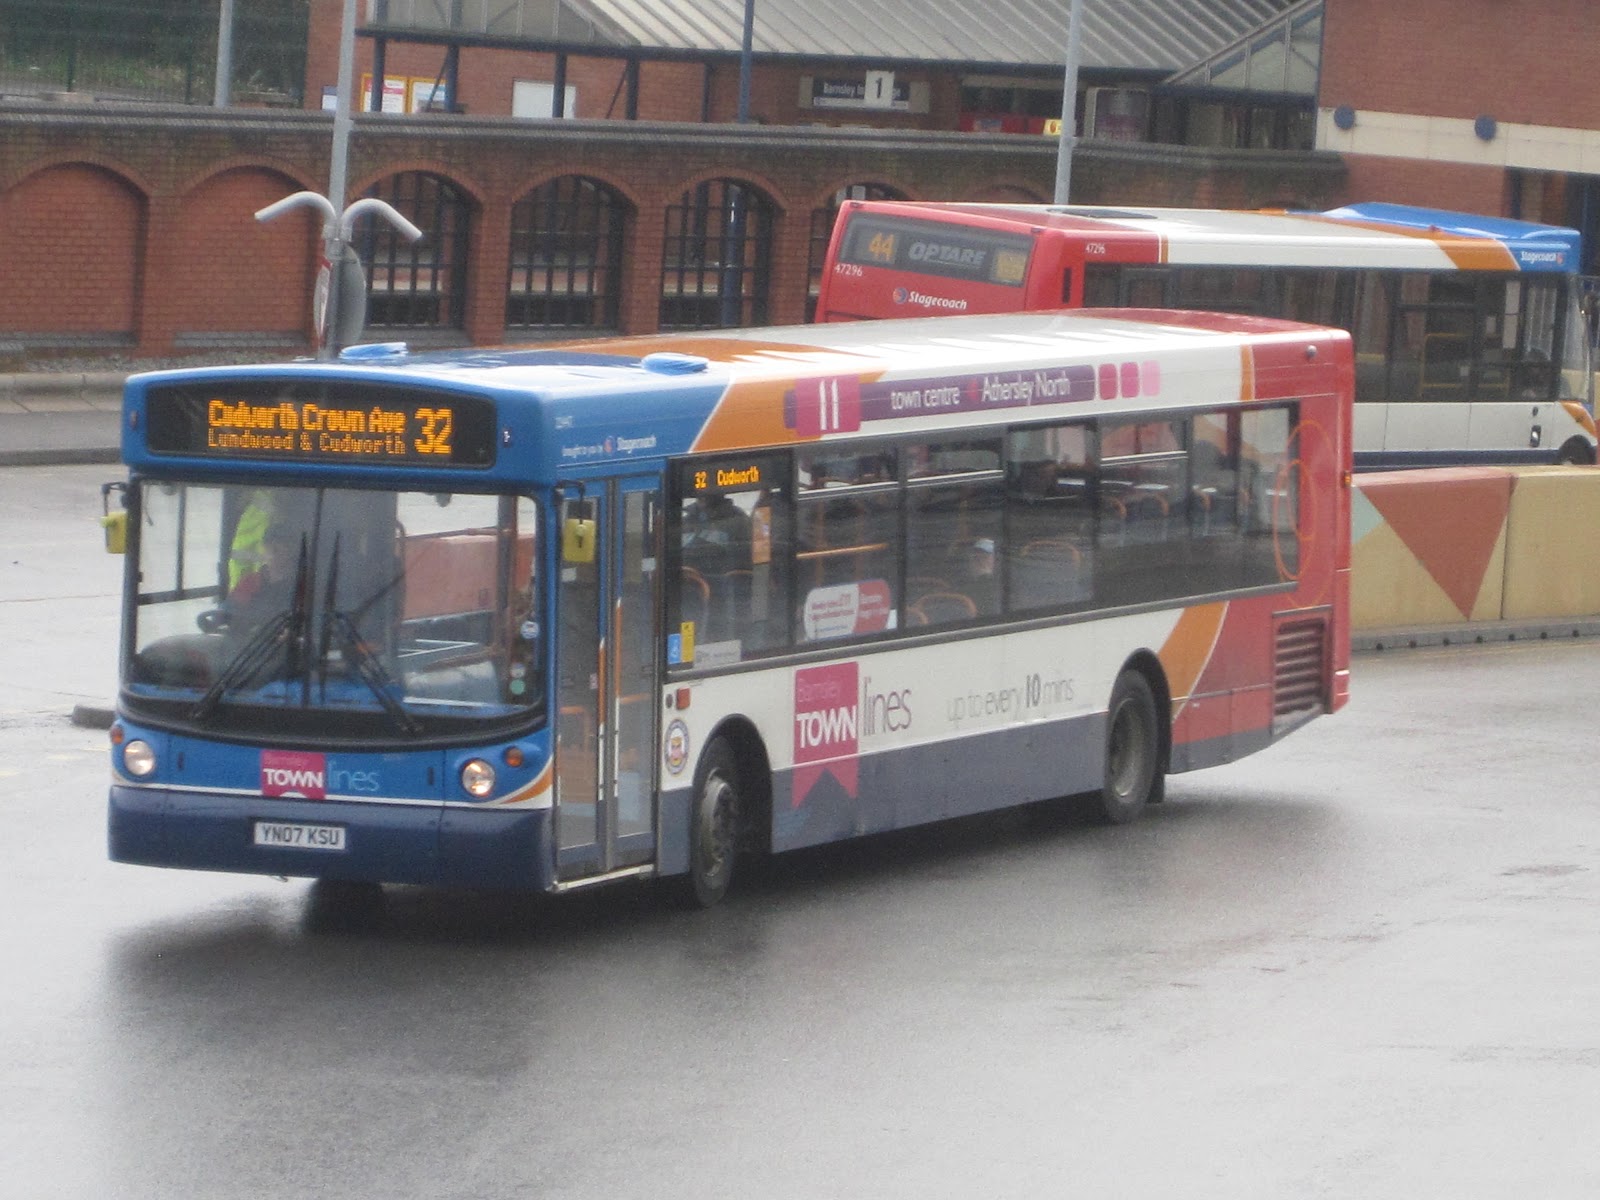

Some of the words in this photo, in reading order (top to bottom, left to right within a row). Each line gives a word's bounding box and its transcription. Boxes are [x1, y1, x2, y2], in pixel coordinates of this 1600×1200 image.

[875, 77, 883, 99] 1
[869, 232, 895, 262] 44
[908, 241, 986, 265] OPTARE
[1086, 242, 1105, 255] 47296
[1521, 250, 1557, 264] Stagecoach
[834, 263, 863, 277] 47296
[908, 290, 967, 310] Stagecoach
[890, 389, 921, 410] town
[924, 386, 960, 407] centre
[981, 376, 1034, 406] Athersley
[1034, 370, 1071, 398] North
[208, 399, 299, 430] Cudworth
[302, 403, 366, 432] Crown
[368, 406, 406, 433] Ave
[208, 428, 294, 450] Lundwood
[300, 431, 312, 451] &
[319, 432, 406, 455] Cudworth
[414, 407, 452, 454] 32
[694, 471, 708, 489] 32
[716, 465, 760, 486] Cudworth
[1025, 672, 1042, 708] 10
[796, 705, 857, 749] TOWN
[863, 676, 912, 737] lines
[263, 768, 324, 789] TOWN
[327, 759, 380, 793] lines
[261, 825, 303, 844] YN07
[307, 830, 340, 846] KSU
